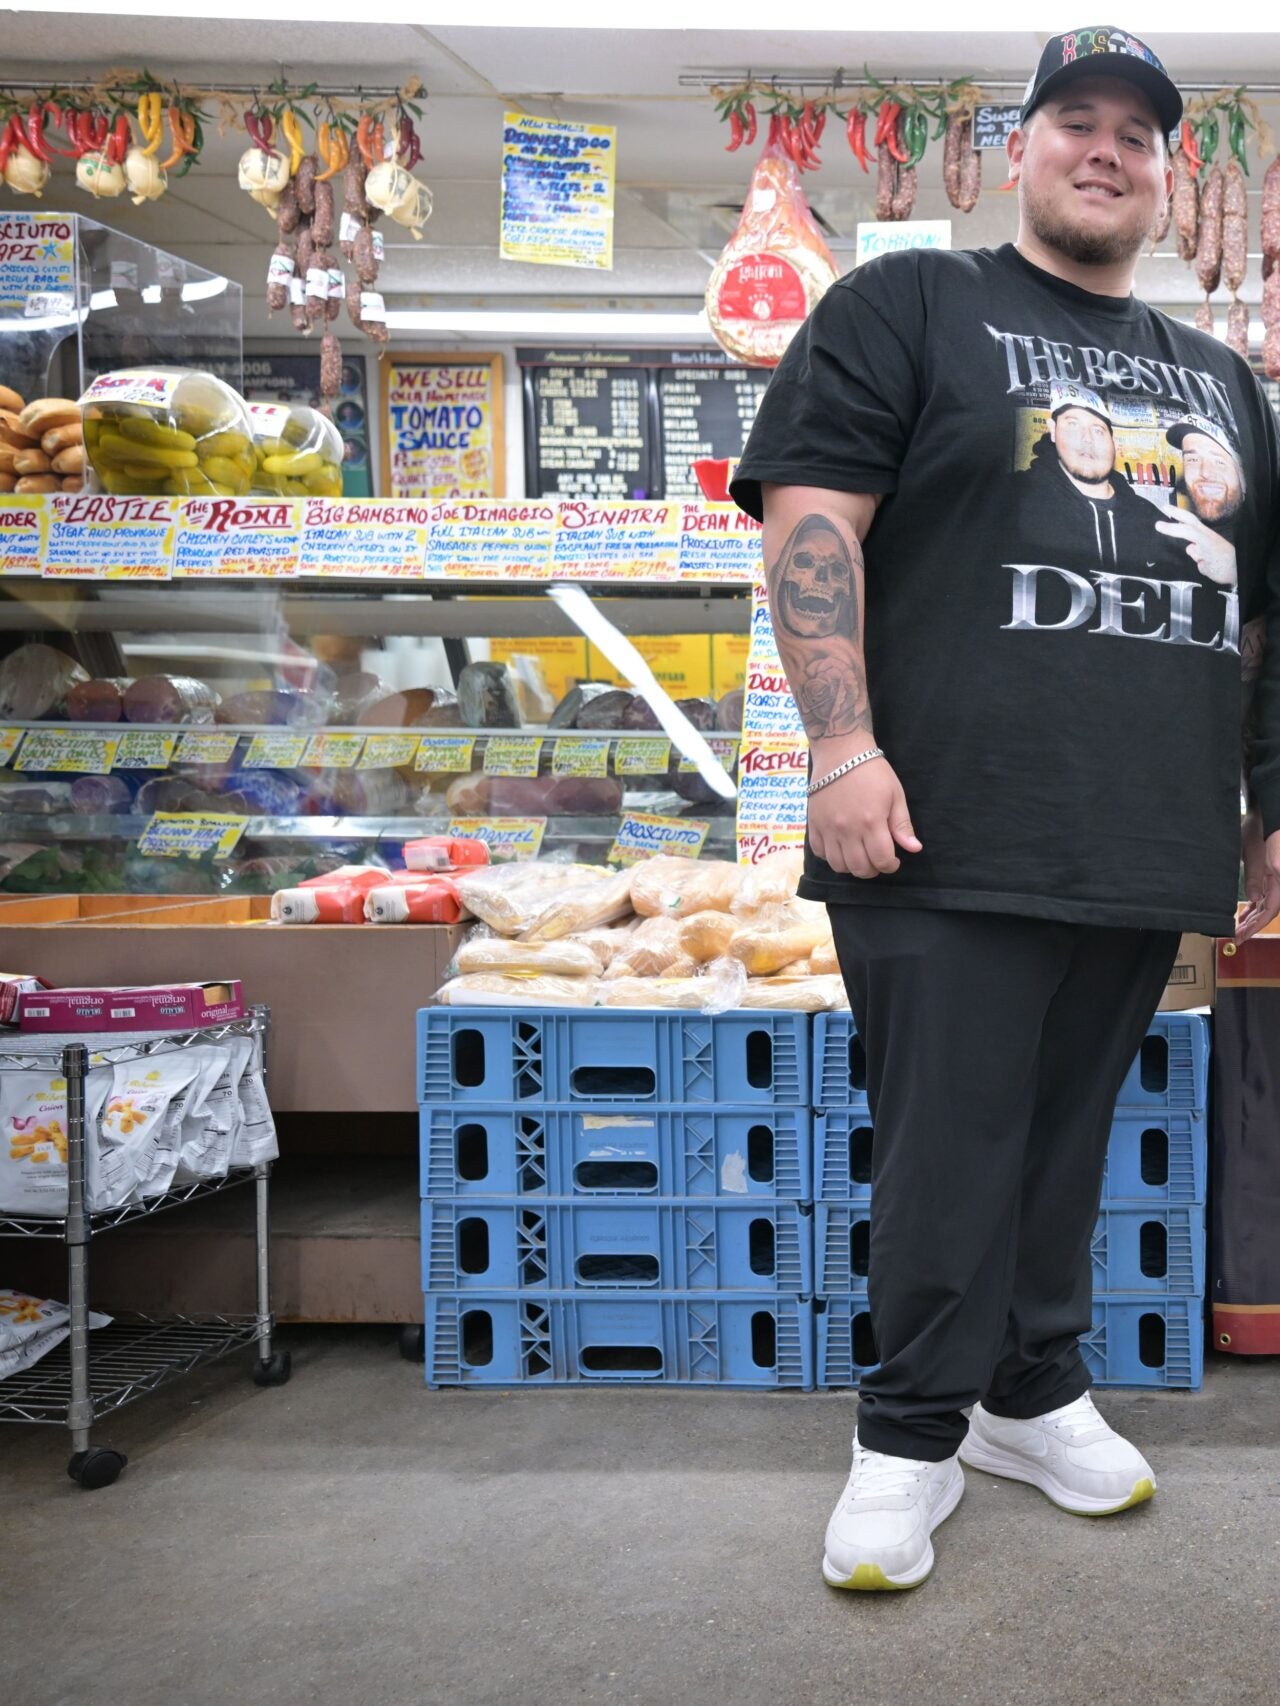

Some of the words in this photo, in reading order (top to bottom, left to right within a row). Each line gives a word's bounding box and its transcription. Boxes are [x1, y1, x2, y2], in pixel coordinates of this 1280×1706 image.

[0, 222, 71, 241] SCIUTTO
[397, 370, 431, 388] WE
[436, 368, 487, 389] SELL
[985, 323, 1082, 395] THE
[1078, 346, 1241, 444] BOSTON
[391, 405, 482, 430] TOMATO
[398, 431, 470, 451] SAUCE
[52, 497, 71, 510] THE
[64, 497, 173, 523] EASTIE
[307, 499, 324, 507] THE
[683, 505, 700, 513] THE
[181, 500, 209, 517] THE
[203, 499, 294, 533] ROMA
[305, 507, 343, 526] BIG
[346, 506, 429, 524] BAMBINO
[431, 505, 460, 521] JOE
[462, 505, 554, 523] DIMAGGIO
[562, 502, 669, 529] SINATRA
[682, 512, 730, 531] DEAN
[735, 511, 763, 530] MA
[52, 523, 86, 538] STEAK
[178, 532, 230, 544] CHICKEN
[304, 530, 350, 541] ITALIAN
[355, 529, 377, 540] SUB
[430, 526, 456, 538] FULL
[459, 526, 508, 537] ITALIAN
[512, 527, 536, 538] SUB
[556, 529, 604, 542] ITALIAN
[605, 528, 625, 540] SUB
[681, 534, 743, 549] PROSCIUTTO
[223, 547, 245, 557] RED
[1000, 563, 1242, 657] DELI
[746, 692, 781, 708] ROAST
[740, 747, 808, 773] TRIPLE
[740, 801, 778, 811] FRENCH
[476, 827, 535, 842] DANIEL
[618, 822, 701, 843] PROSCIUTTO
[739, 835, 757, 849] THE
[201, 1005, 228, 1019] original
